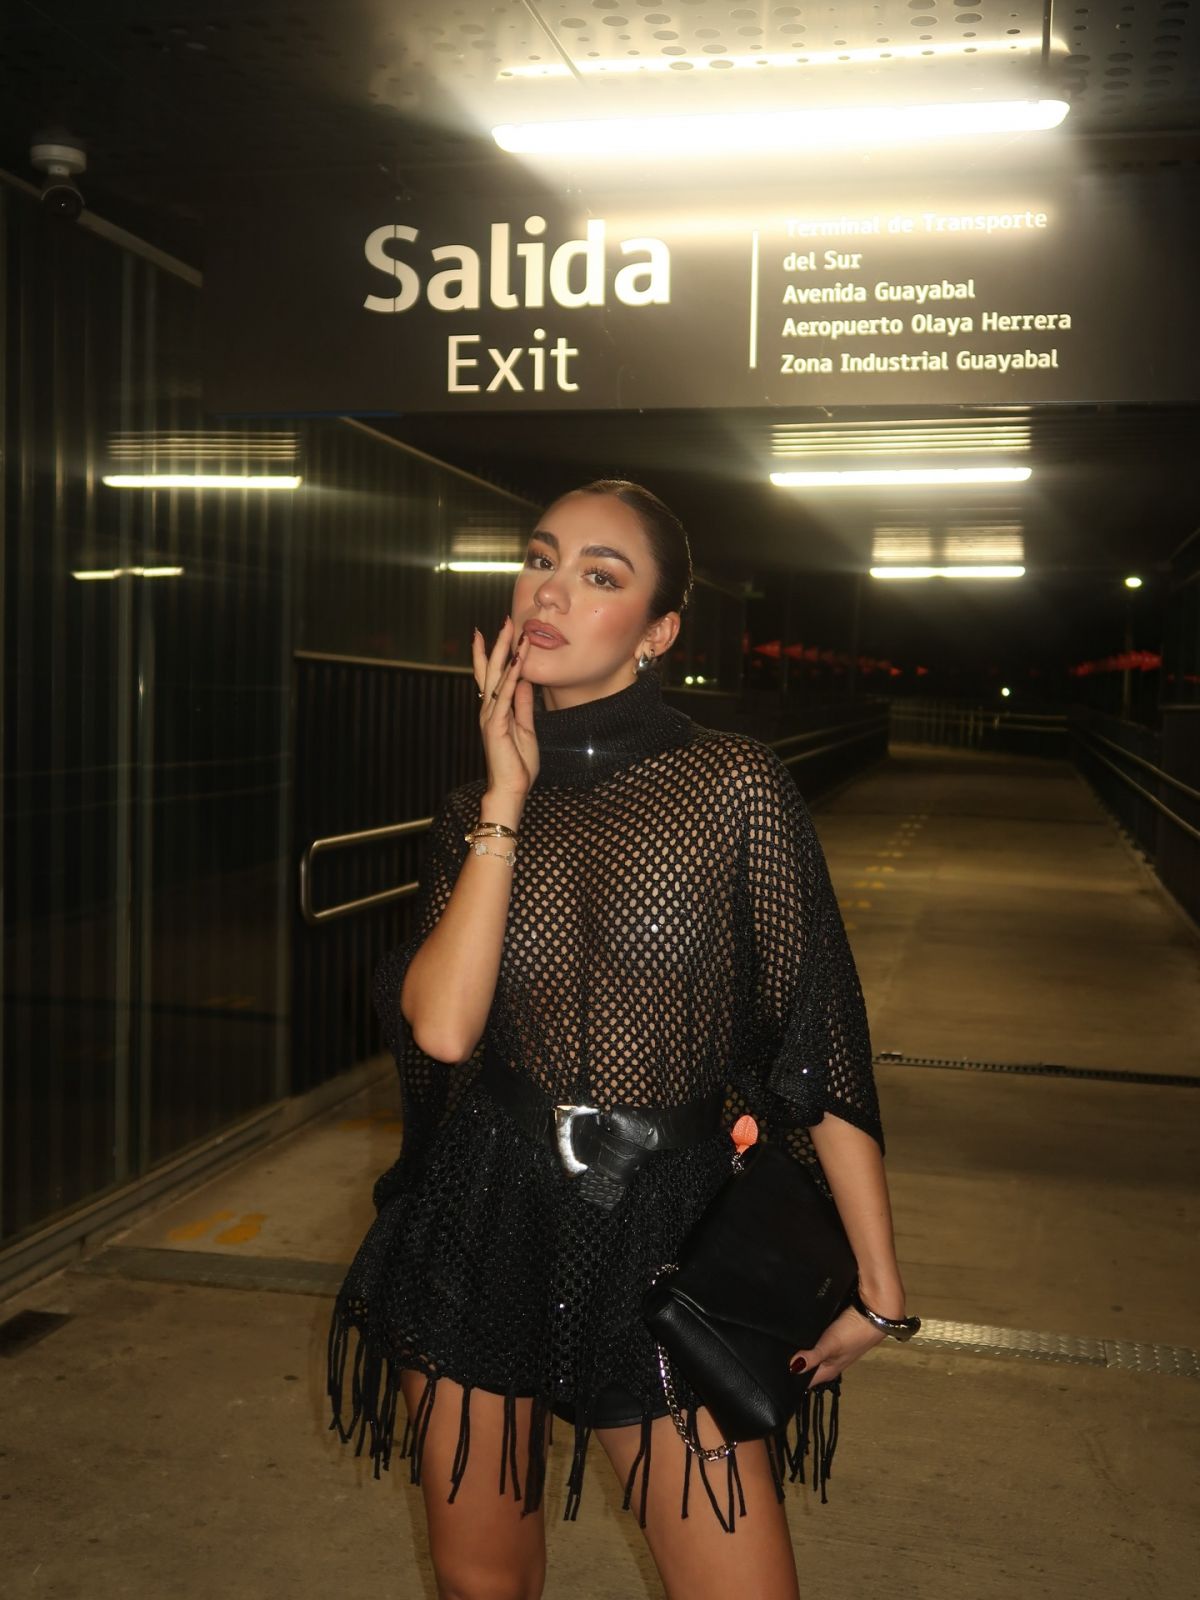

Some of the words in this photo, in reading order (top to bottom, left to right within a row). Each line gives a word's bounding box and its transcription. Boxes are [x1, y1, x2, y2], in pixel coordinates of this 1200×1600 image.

[784, 216, 881, 237] Terminal
[887, 215, 914, 233] de
[922, 210, 1048, 234] Transporte
[363, 215, 671, 313] Salida
[783, 251, 817, 272] del
[823, 250, 863, 270] Sur
[782, 282, 867, 304] Avenida
[874, 279, 976, 304] Guayabal
[782, 317, 904, 340] Aeropuerto
[911, 313, 973, 337] Olaya
[981, 312, 1072, 331] Herrera
[447, 328, 580, 393] Exit
[780, 354, 833, 374] Zona
[840, 350, 950, 373] Industrial
[956, 348, 1059, 373] Guayabal
